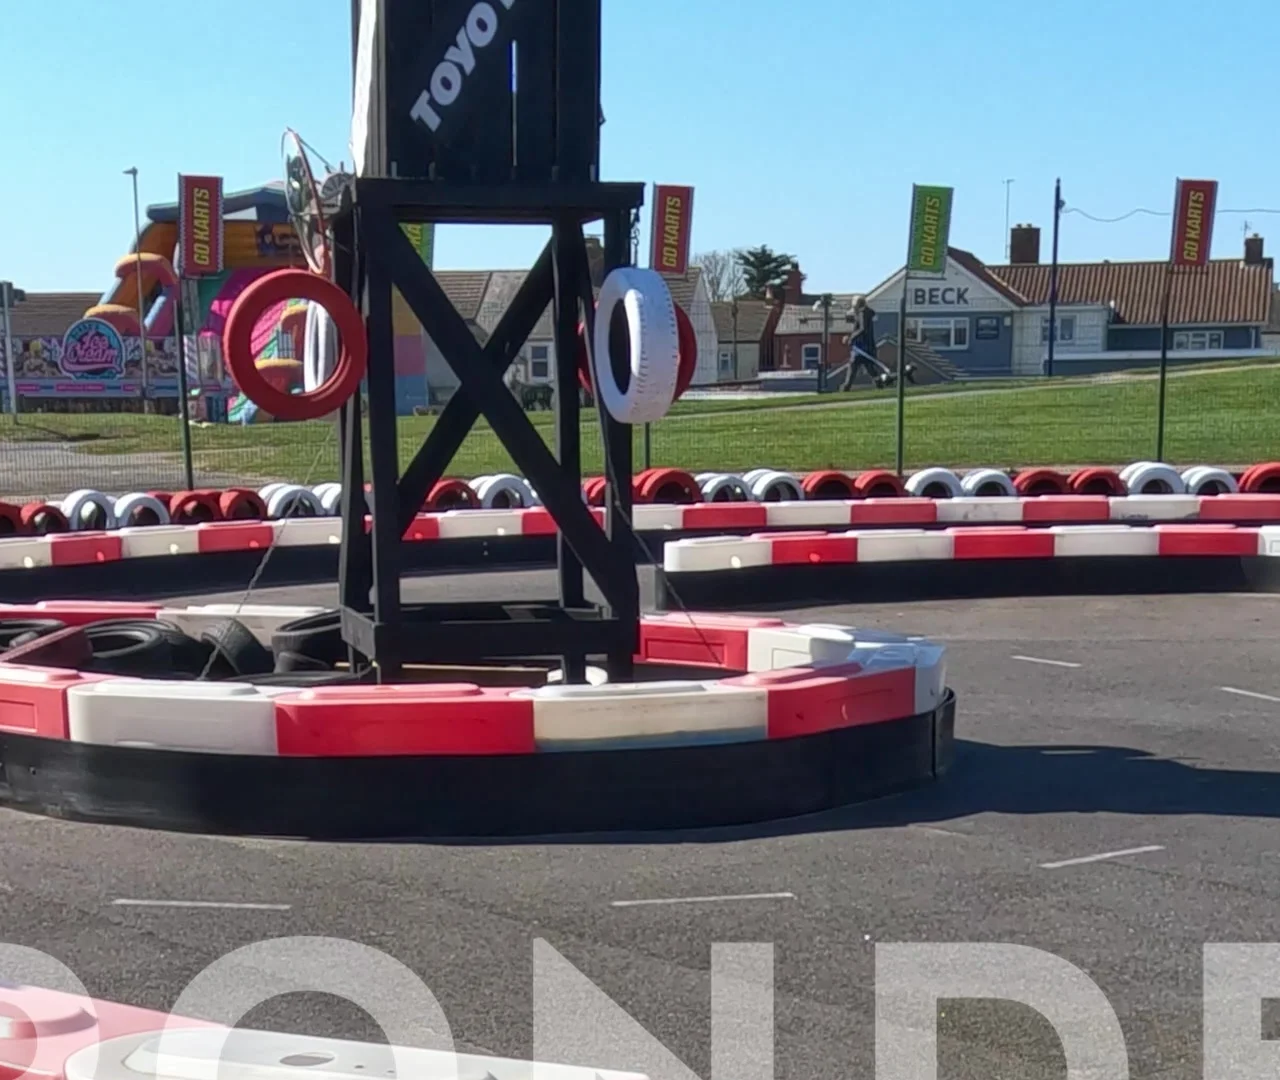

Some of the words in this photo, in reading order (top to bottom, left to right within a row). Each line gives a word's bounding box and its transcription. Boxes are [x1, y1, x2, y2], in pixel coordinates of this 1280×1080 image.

[193, 188, 210, 241] KARTS
[663, 197, 680, 246] KARTS
[923, 197, 940, 244] KARTS
[1185, 191, 1204, 239] KARTS
[193, 242, 210, 265] GO
[662, 247, 677, 267] GO
[920, 247, 935, 266] GO
[1183, 240, 1198, 261] GO
[914, 287, 969, 305] BECK
